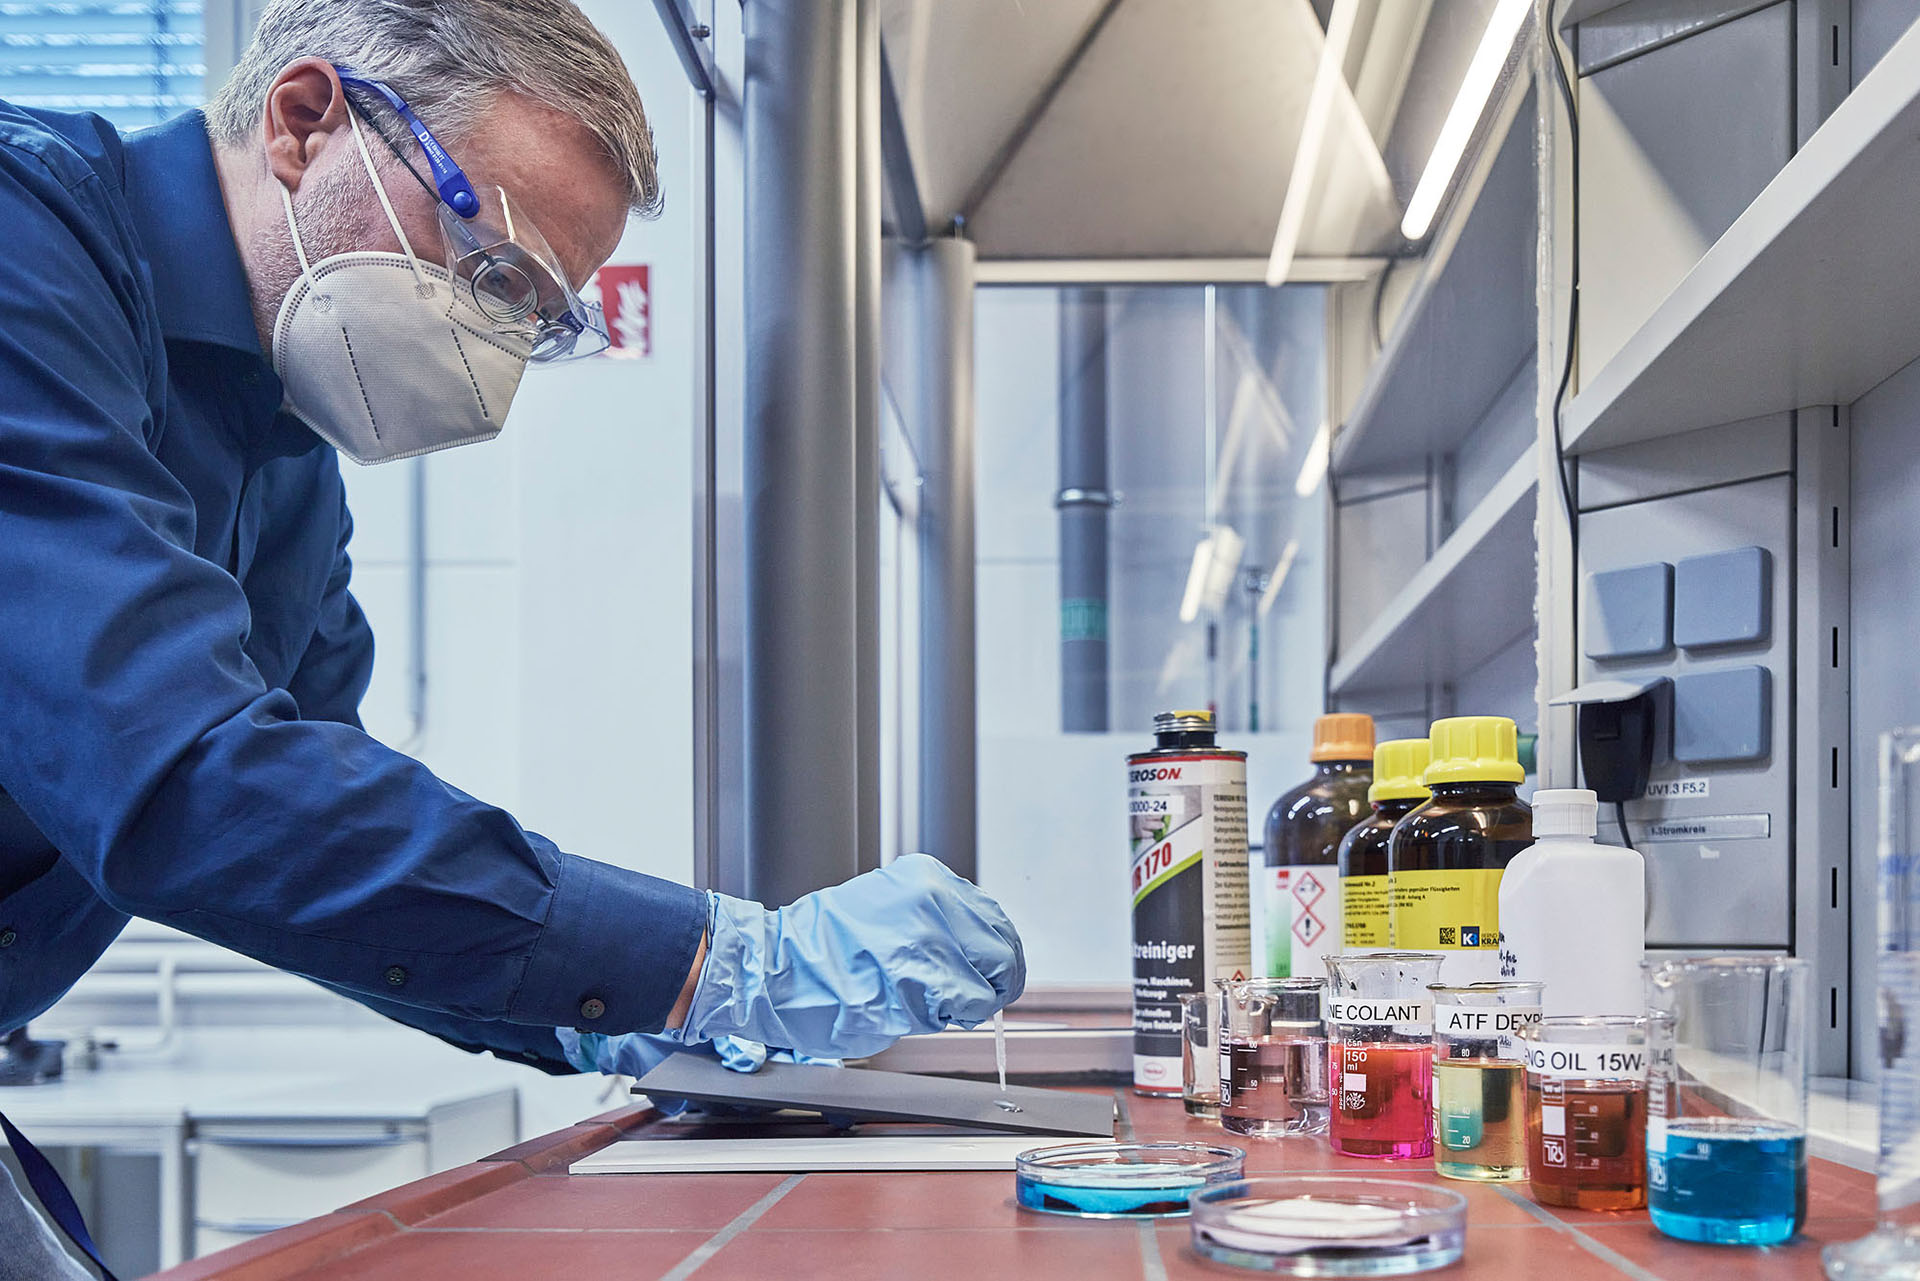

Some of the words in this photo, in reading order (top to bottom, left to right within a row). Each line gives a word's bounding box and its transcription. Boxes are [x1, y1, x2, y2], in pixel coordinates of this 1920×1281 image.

[1648, 783, 1679, 796] UV1.3
[1682, 782, 1706, 793] F5.2
[1144, 842, 1172, 880] 170
[1346, 1005, 1421, 1021] COLANT
[1449, 1012, 1488, 1030] ATF
[1346, 1050, 1368, 1063] 150
[1461, 1048, 1470, 1057] 80
[1347, 1062, 1358, 1072] ml
[1551, 1051, 1587, 1071] OIL
[1251, 1079, 1258, 1088] 50
[1463, 1135, 1471, 1145] 20
